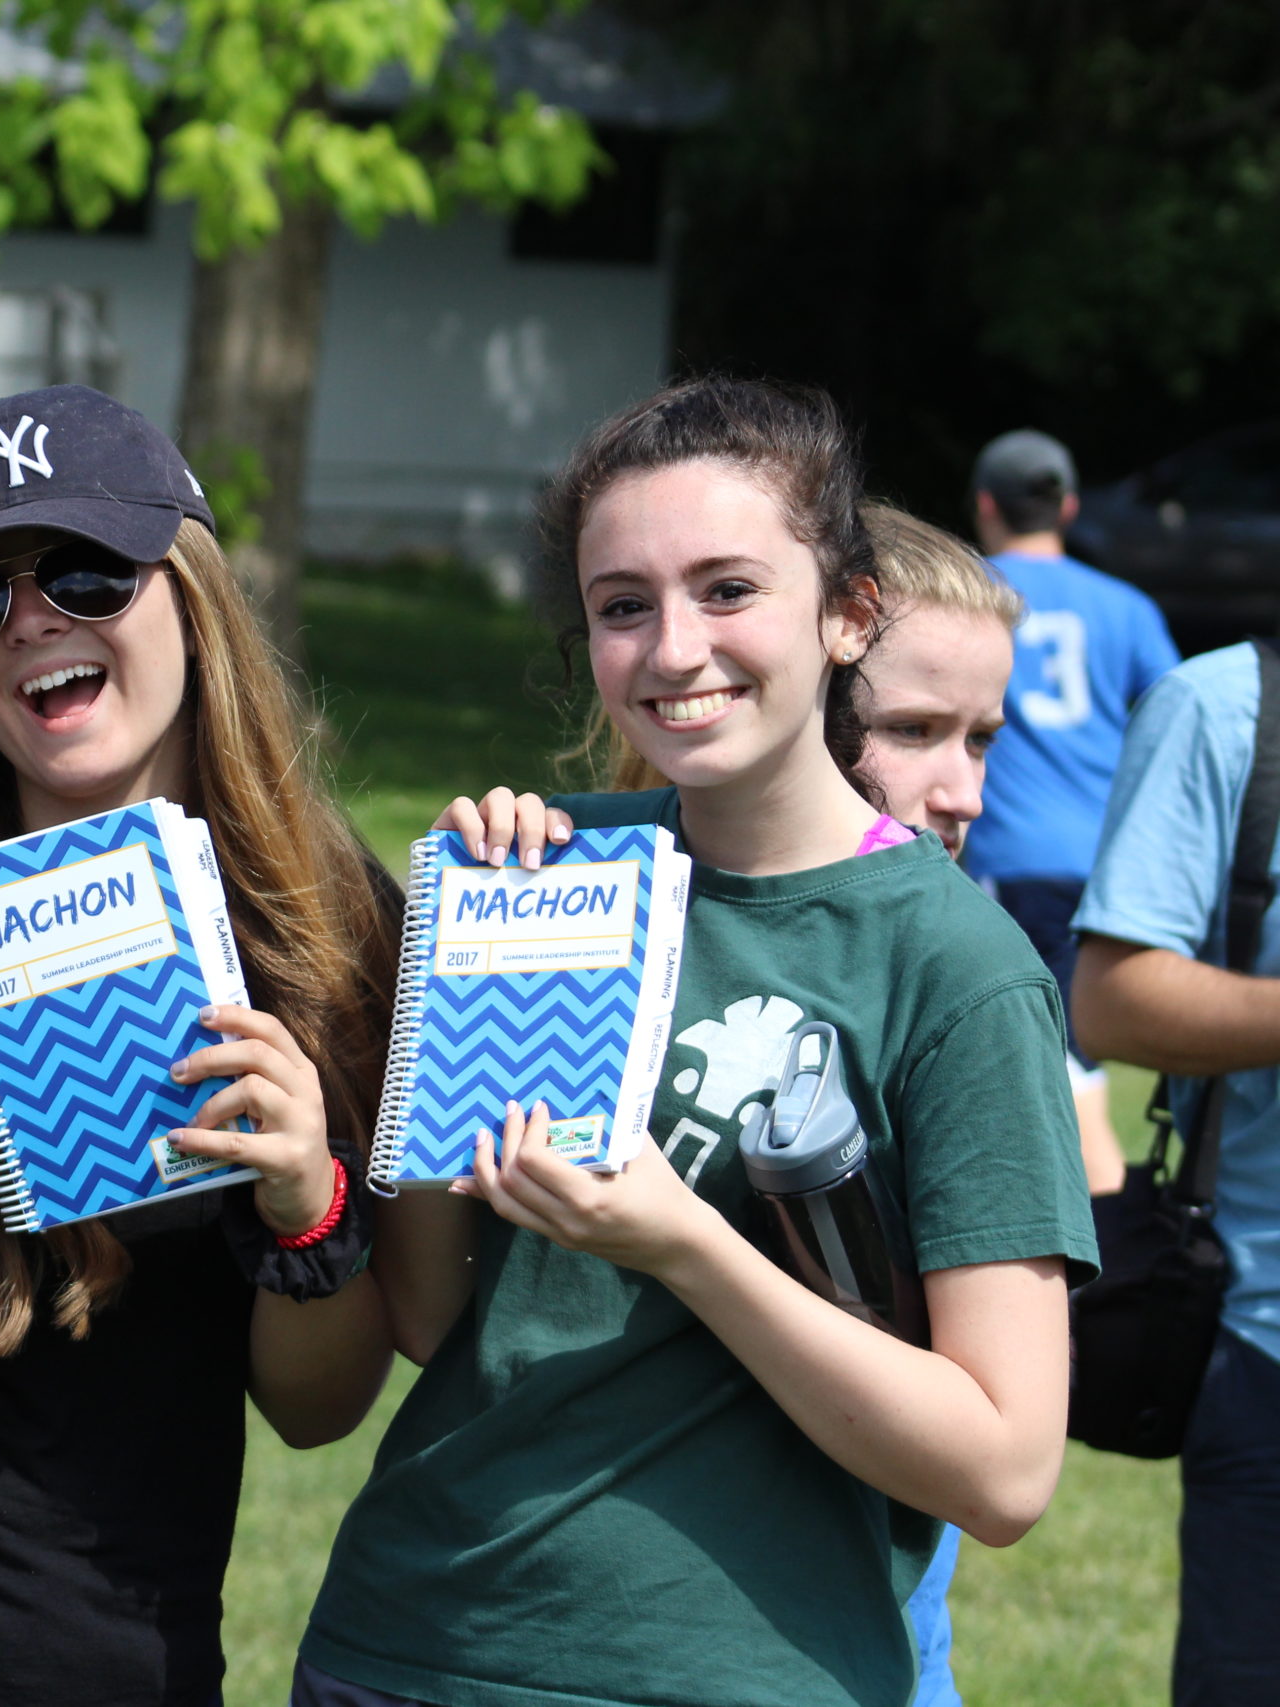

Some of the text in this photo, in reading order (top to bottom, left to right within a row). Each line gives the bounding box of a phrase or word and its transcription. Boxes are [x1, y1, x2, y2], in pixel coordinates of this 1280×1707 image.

[197, 852, 207, 871] MAPS
[202, 839, 217, 880] LEADERSHIP
[455, 883, 619, 924] MACHON
[41, 964, 75, 980] SUMMER
[76, 950, 124, 971] LEADERSHIP
[124, 937, 164, 955] INSTITUTE
[214, 917, 236, 975] PLANNING
[447, 949, 620, 967] 2017 SUMMER LEADERSHIP INSTITUTE
[661, 946, 677, 1000] PLANNING
[647, 1023, 663, 1073] REFLECTION
[632, 1103, 645, 1135] NOTES
[164, 1161, 191, 1175] EISNER
[191, 1158, 198, 1168] &
[556, 1145, 577, 1154] CRANE
[579, 1142, 595, 1152] LAKE
